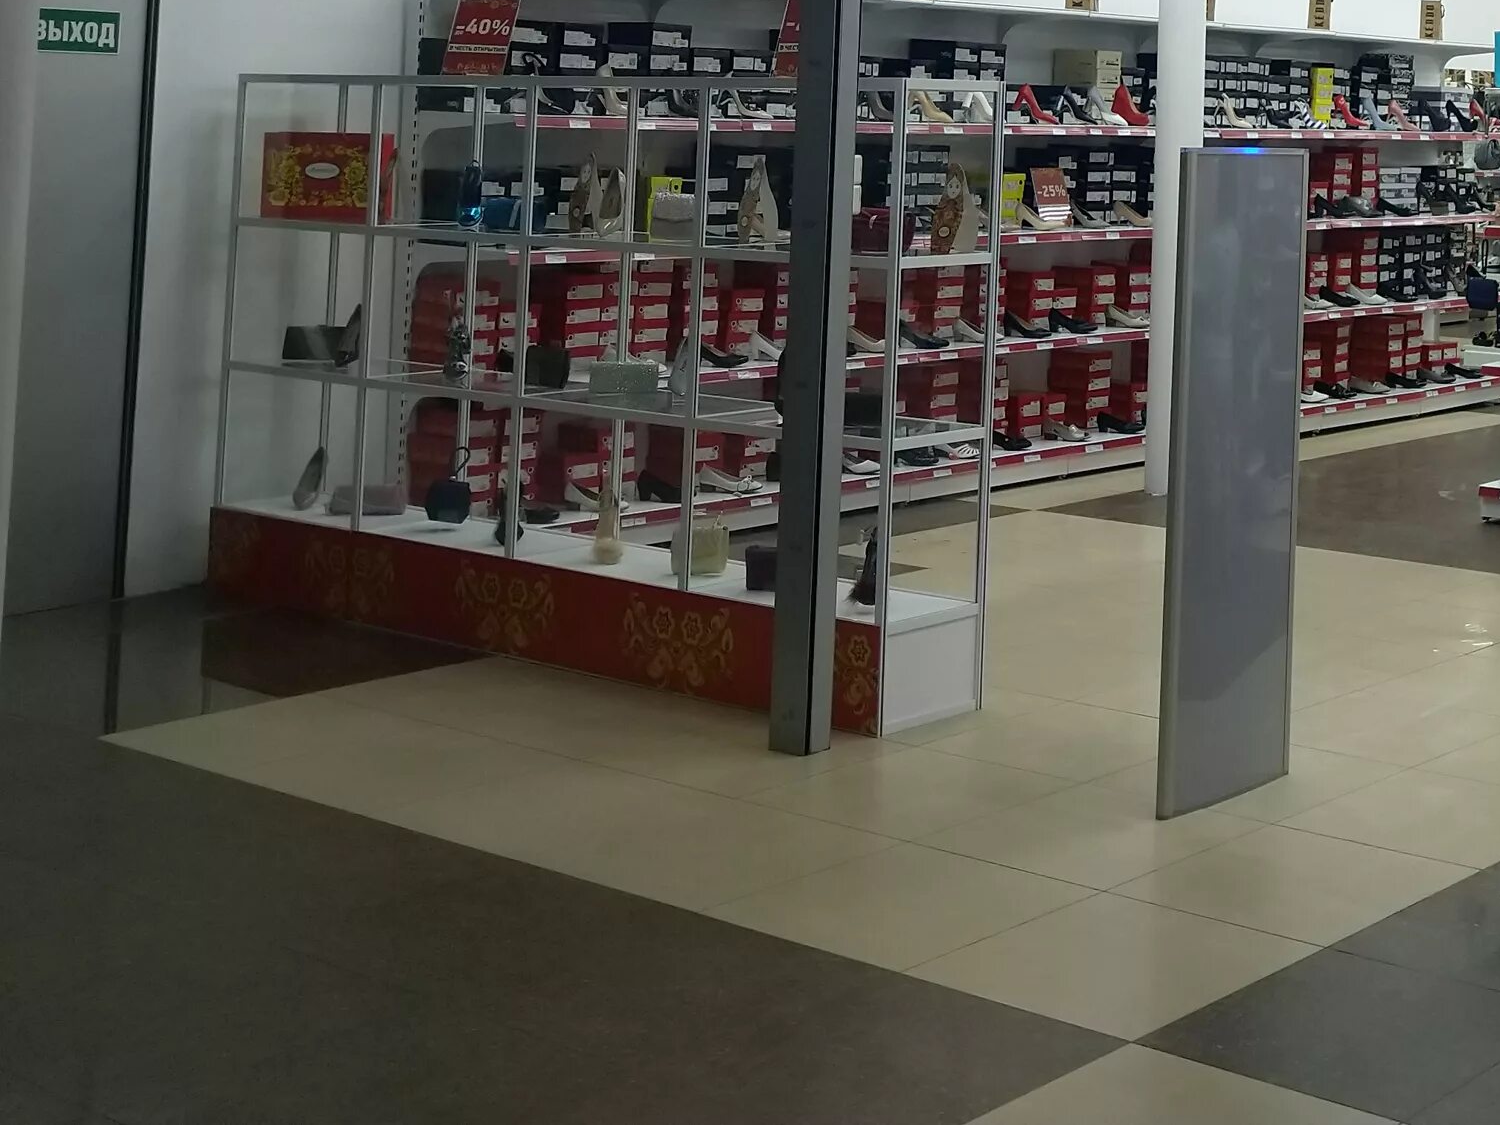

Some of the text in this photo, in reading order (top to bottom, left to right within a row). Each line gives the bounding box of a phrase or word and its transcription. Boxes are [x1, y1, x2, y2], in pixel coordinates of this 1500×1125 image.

[36, 19, 116, 48] ВЫХОД
[455, 18, 511, 36] -40%
[1037, 185, 1066, 197] -25%
